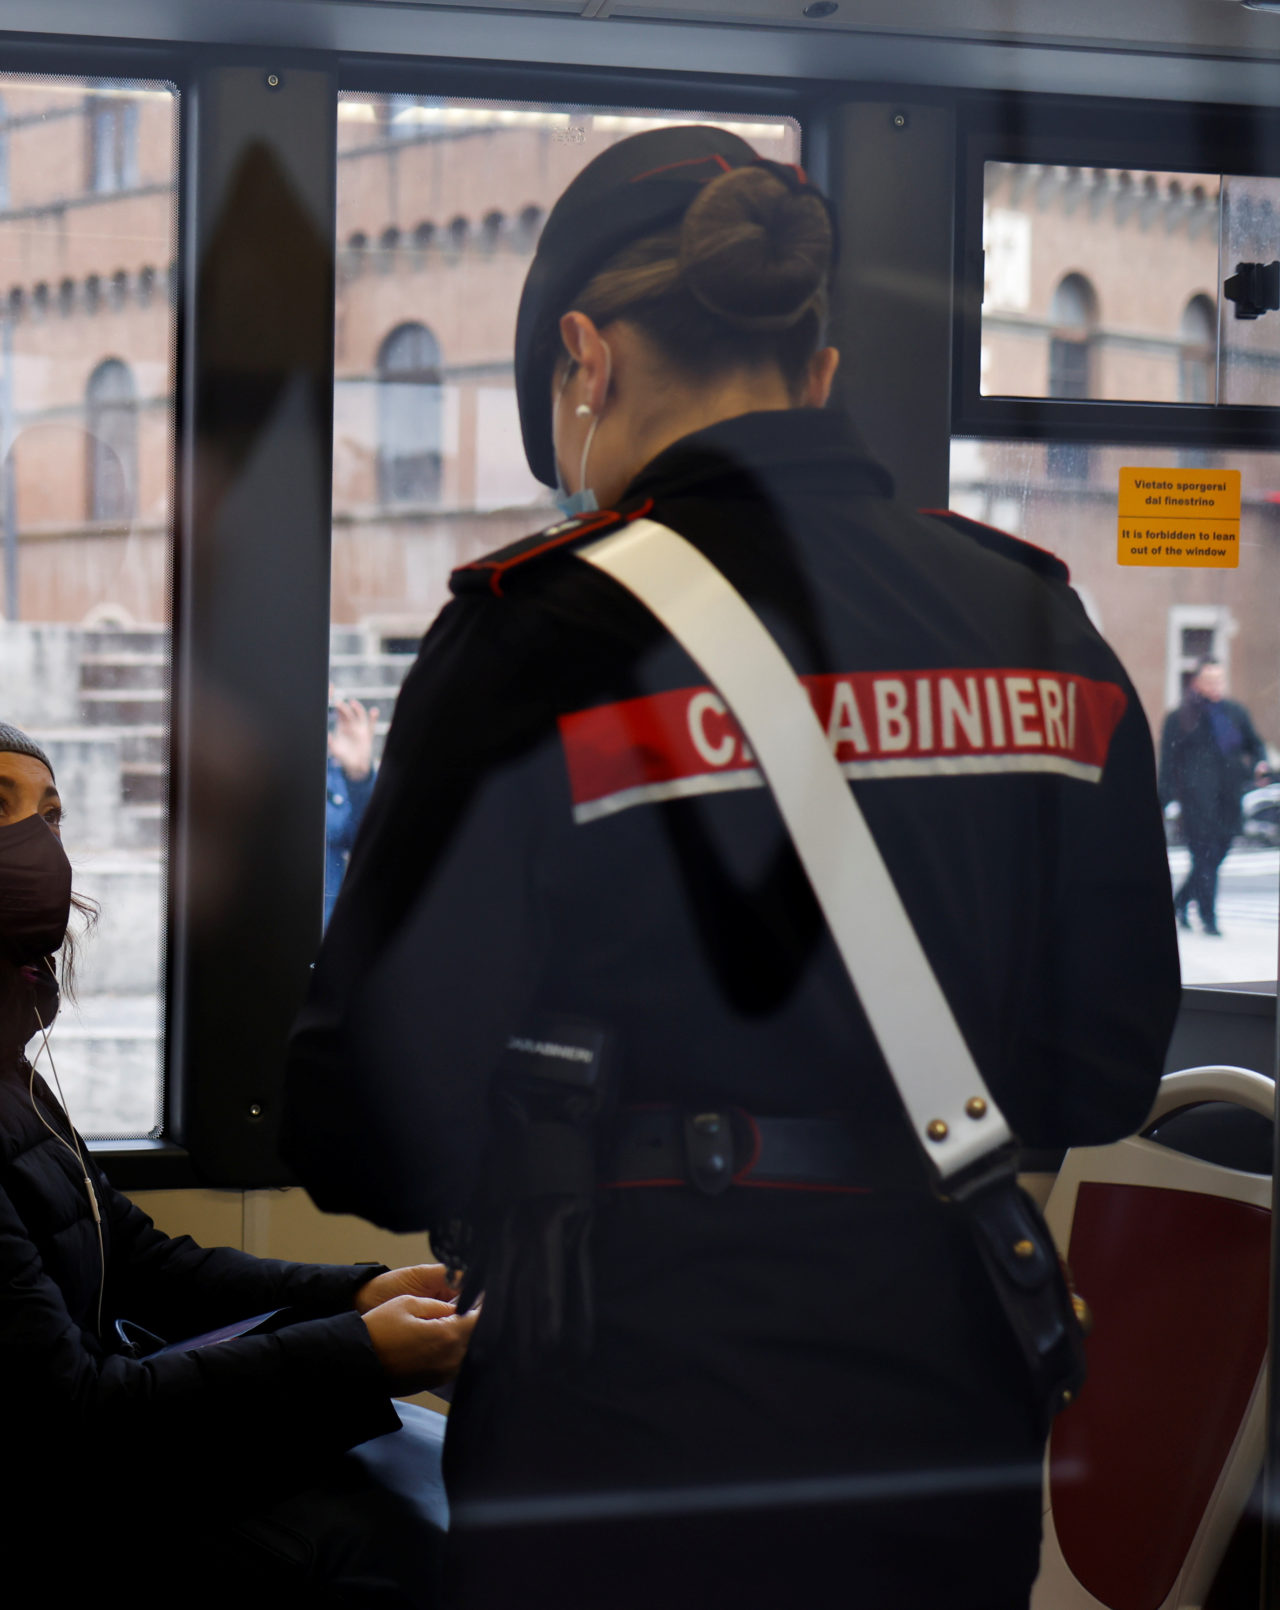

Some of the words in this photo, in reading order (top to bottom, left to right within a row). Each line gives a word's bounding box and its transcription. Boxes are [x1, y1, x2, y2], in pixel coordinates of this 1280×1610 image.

[1134, 480, 1174, 490] Vietato
[1176, 482, 1227, 493] sporgersi
[1145, 496, 1162, 505] dal
[1165, 496, 1215, 507] finestrino
[1122, 530, 1130, 539] It
[1133, 530, 1142, 539] is
[1146, 530, 1196, 540] forbidden
[1199, 531, 1210, 541] to
[1213, 532, 1236, 541] lean
[1130, 546, 1148, 555] out
[1151, 546, 1162, 555] of
[1165, 546, 1182, 555] the
[1186, 546, 1227, 557] window
[687, 677, 1077, 767] CABINIERI
